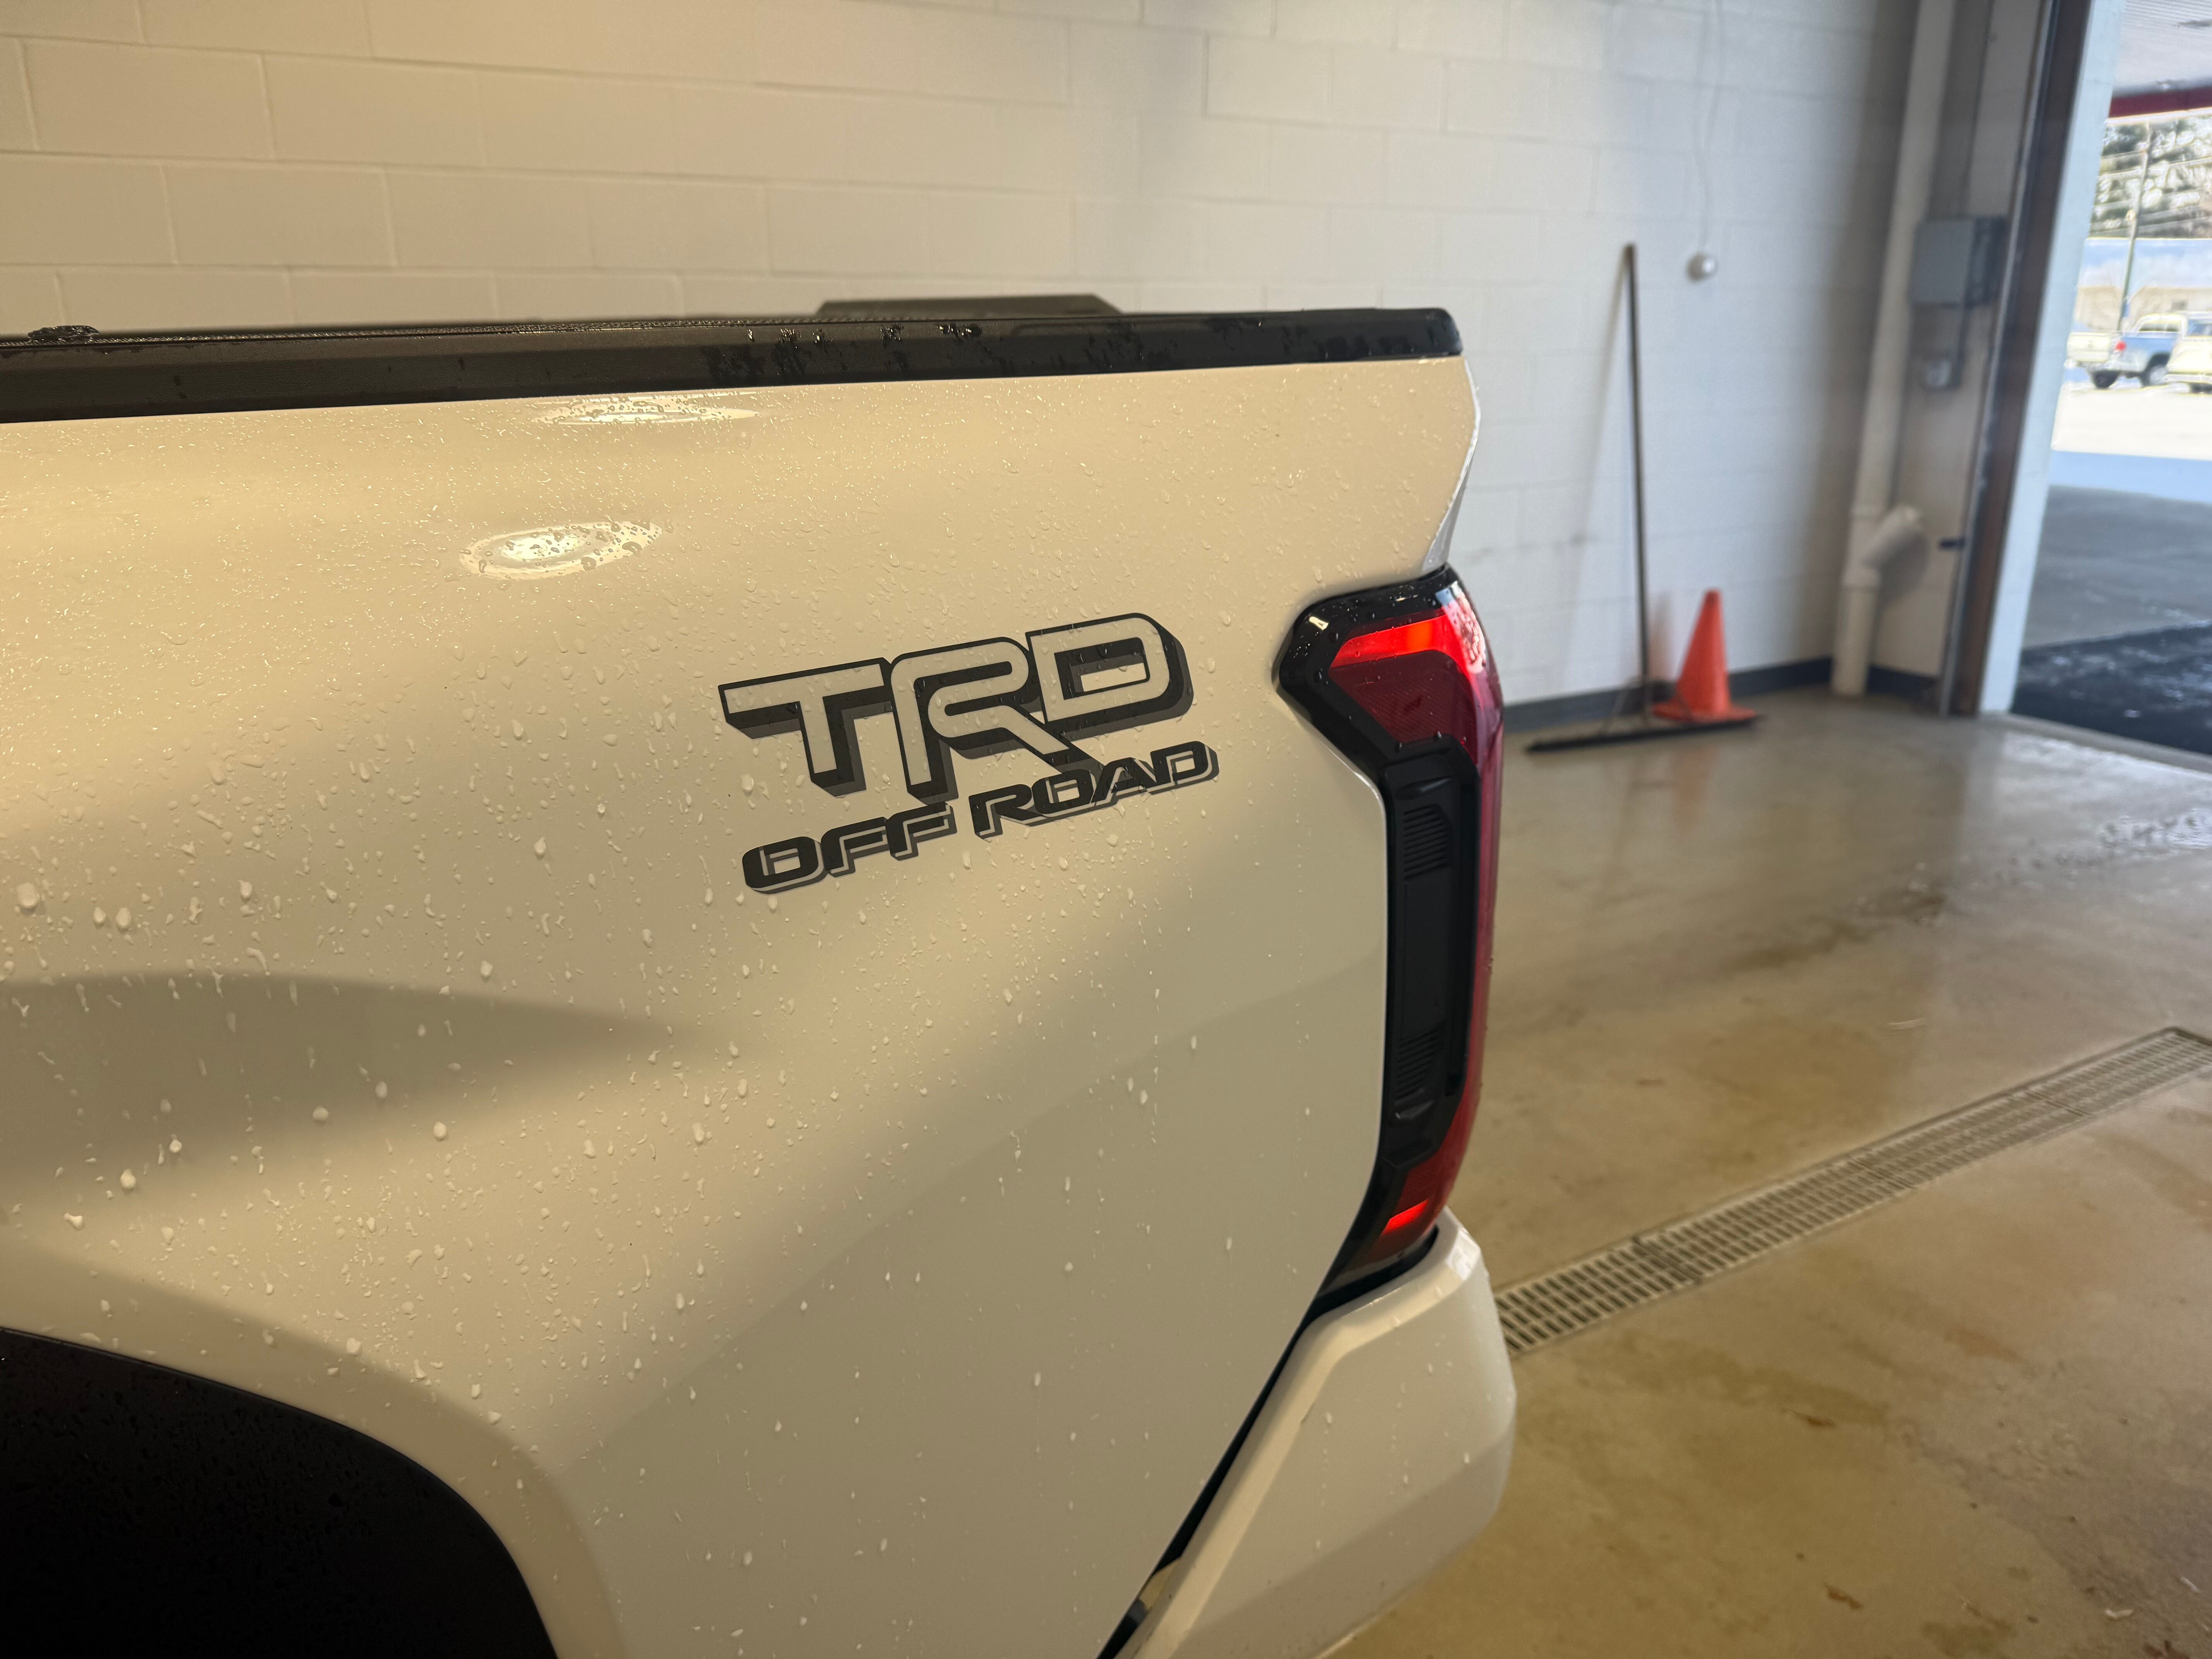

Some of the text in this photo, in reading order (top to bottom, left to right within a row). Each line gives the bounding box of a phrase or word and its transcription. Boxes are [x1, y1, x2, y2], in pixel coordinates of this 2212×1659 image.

[718, 613, 1194, 805] TRD
[742, 741, 1219, 895] OFF ROAD
